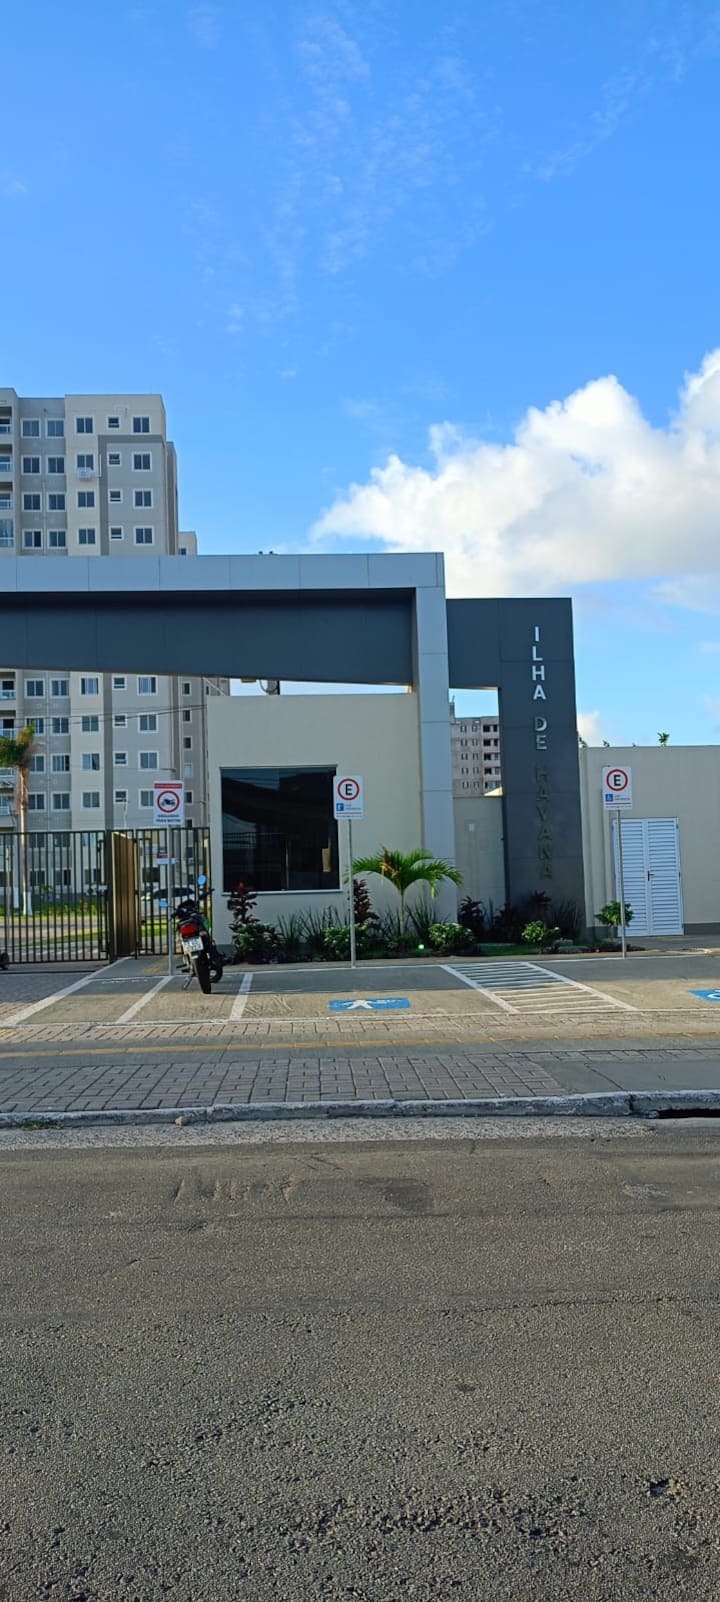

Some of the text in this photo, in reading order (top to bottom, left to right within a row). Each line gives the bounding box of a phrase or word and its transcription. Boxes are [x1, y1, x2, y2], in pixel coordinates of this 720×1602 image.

[532, 626, 553, 880] ILHA DE HAVANA
[613, 774, 622, 787] E
[345, 783, 353, 796] E
